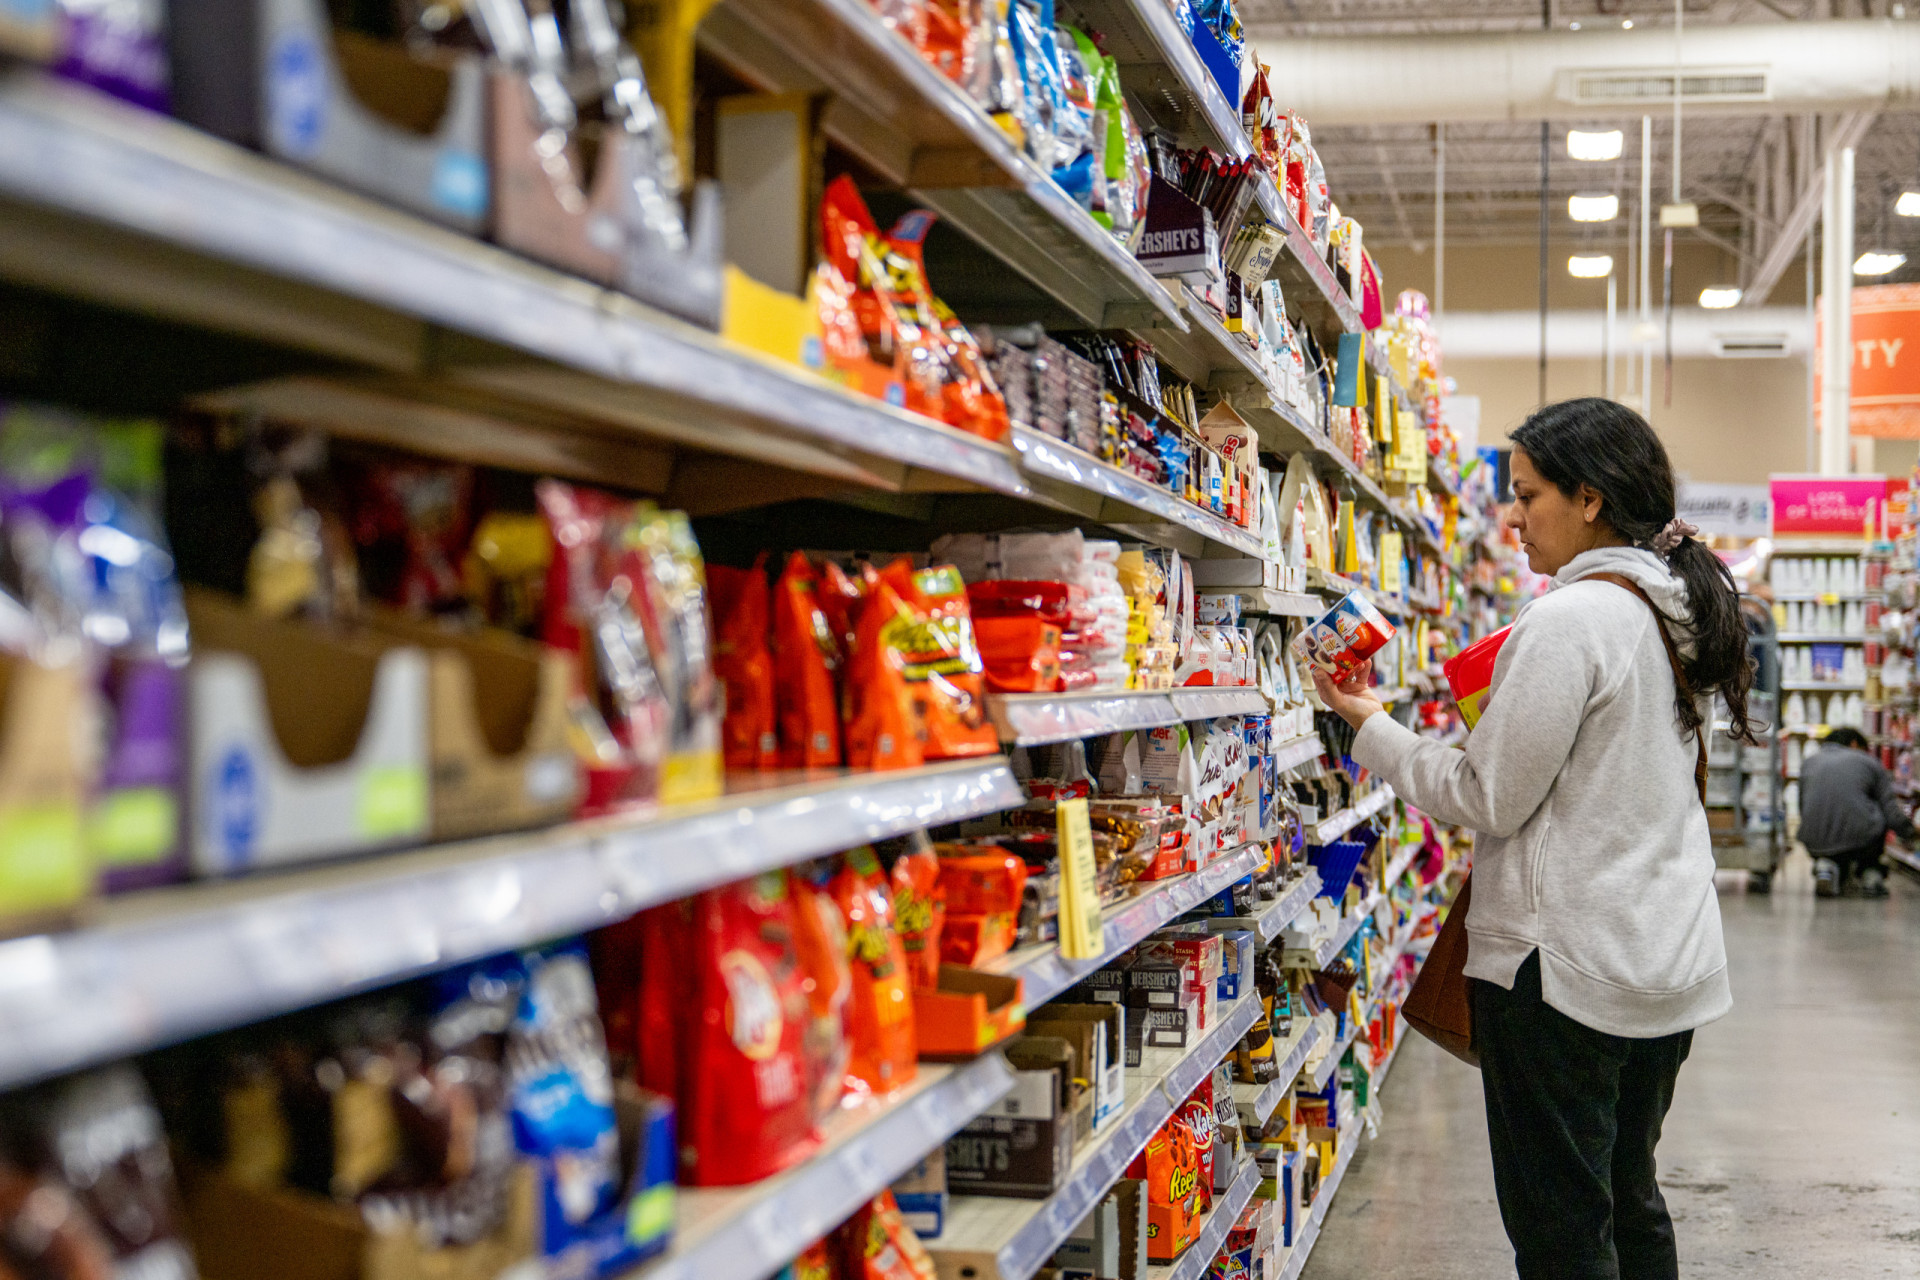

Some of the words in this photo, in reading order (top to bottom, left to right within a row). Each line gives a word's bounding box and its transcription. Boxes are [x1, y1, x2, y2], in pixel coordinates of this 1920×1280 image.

[1138, 228, 1200, 254] ERSHEY'S
[1856, 337, 1904, 370] TY
[1131, 971, 1178, 987] HERSHEY'S
[1168, 1165, 1198, 1203] Ree
